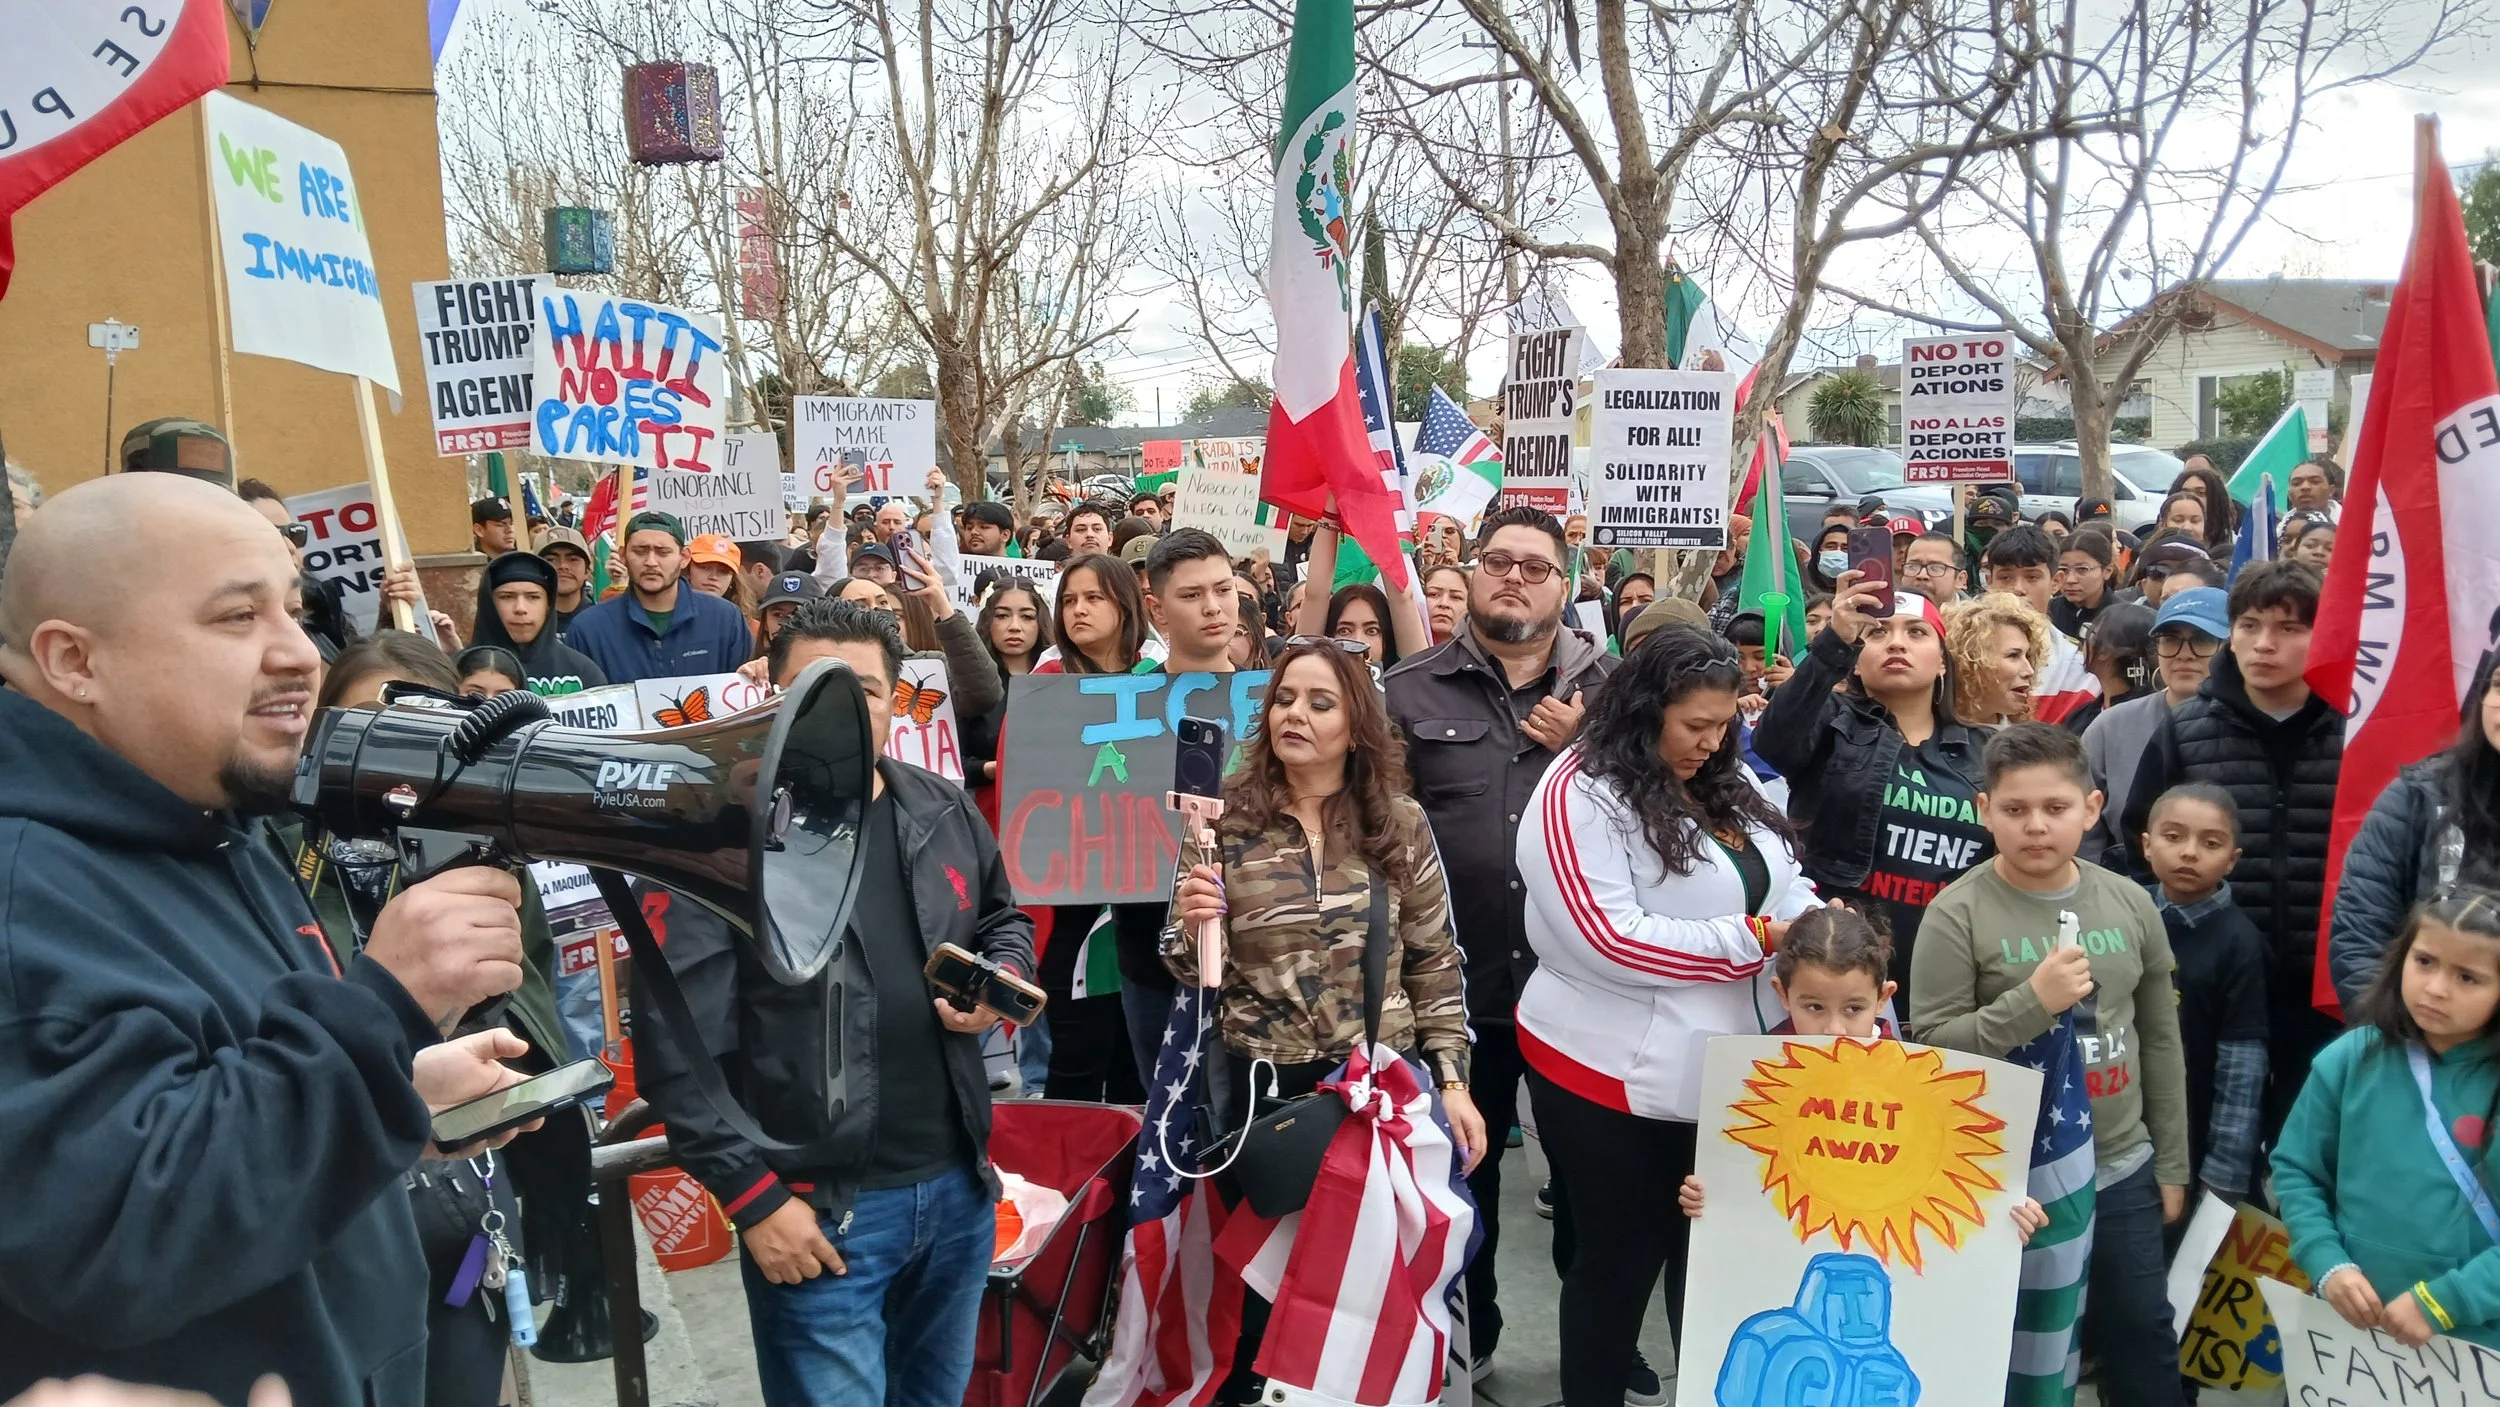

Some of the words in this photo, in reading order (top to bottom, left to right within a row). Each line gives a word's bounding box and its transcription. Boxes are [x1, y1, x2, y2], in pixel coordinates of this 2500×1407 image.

[219, 132, 284, 203] WE
[299, 160, 349, 223] ARE
[1515, 330, 1572, 381] FIGHT
[1911, 344, 1958, 362] NO
[1963, 340, 2005, 359] TO
[1911, 362, 2004, 378] DEPORT
[560, 366, 617, 406] NO
[625, 379, 682, 425] ES
[1910, 379, 2004, 396] ATIONS
[804, 401, 917, 422] IMMIGRANTS
[1507, 379, 1574, 421] TRUMP'S
[1604, 390, 1720, 411] LEGALIZATION
[835, 426, 888, 444] MAKE
[1910, 418, 1941, 430] NO
[1944, 418, 1960, 429] A
[1963, 416, 2005, 428] LAS
[537, 399, 640, 456] PARA
[638, 420, 715, 473] TI
[1628, 426, 1660, 446] FOR
[1667, 427, 1701, 446] ALL!
[1909, 432, 2006, 447] DEPORT
[1237, 441, 1254, 456] IS
[1504, 435, 1569, 477] AGENDA
[1909, 447, 2006, 460] ACIONES
[814, 463, 894, 492] GAT
[1605, 463, 1707, 481] SOLIDARITY
[1909, 465, 1949, 479] FRSO
[656, 471, 757, 500] IGNORANCE
[1636, 485, 1682, 502] WITH
[684, 497, 729, 511] NOT
[1601, 506, 1720, 524] IMMIGRANTS!
[297, 502, 377, 540] TO
[1616, 530, 1643, 538] SILICON
[1664, 538, 1702, 546] COMMITTEE
[303, 539, 383, 571] ORT
[596, 760, 675, 791] PYLE
[1088, 741, 1128, 787] A
[593, 790, 666, 808] PyleUSA.com
[1884, 783, 1984, 826] ANIDA
[1886, 823, 1983, 869] TIENE
[564, 935, 629, 969] FRO
[2001, 936, 2039, 963] LA
[1799, 1097, 1903, 1130] MELT
[1804, 1135, 1901, 1165] AWAY
[635, 1184, 667, 1215] THE
